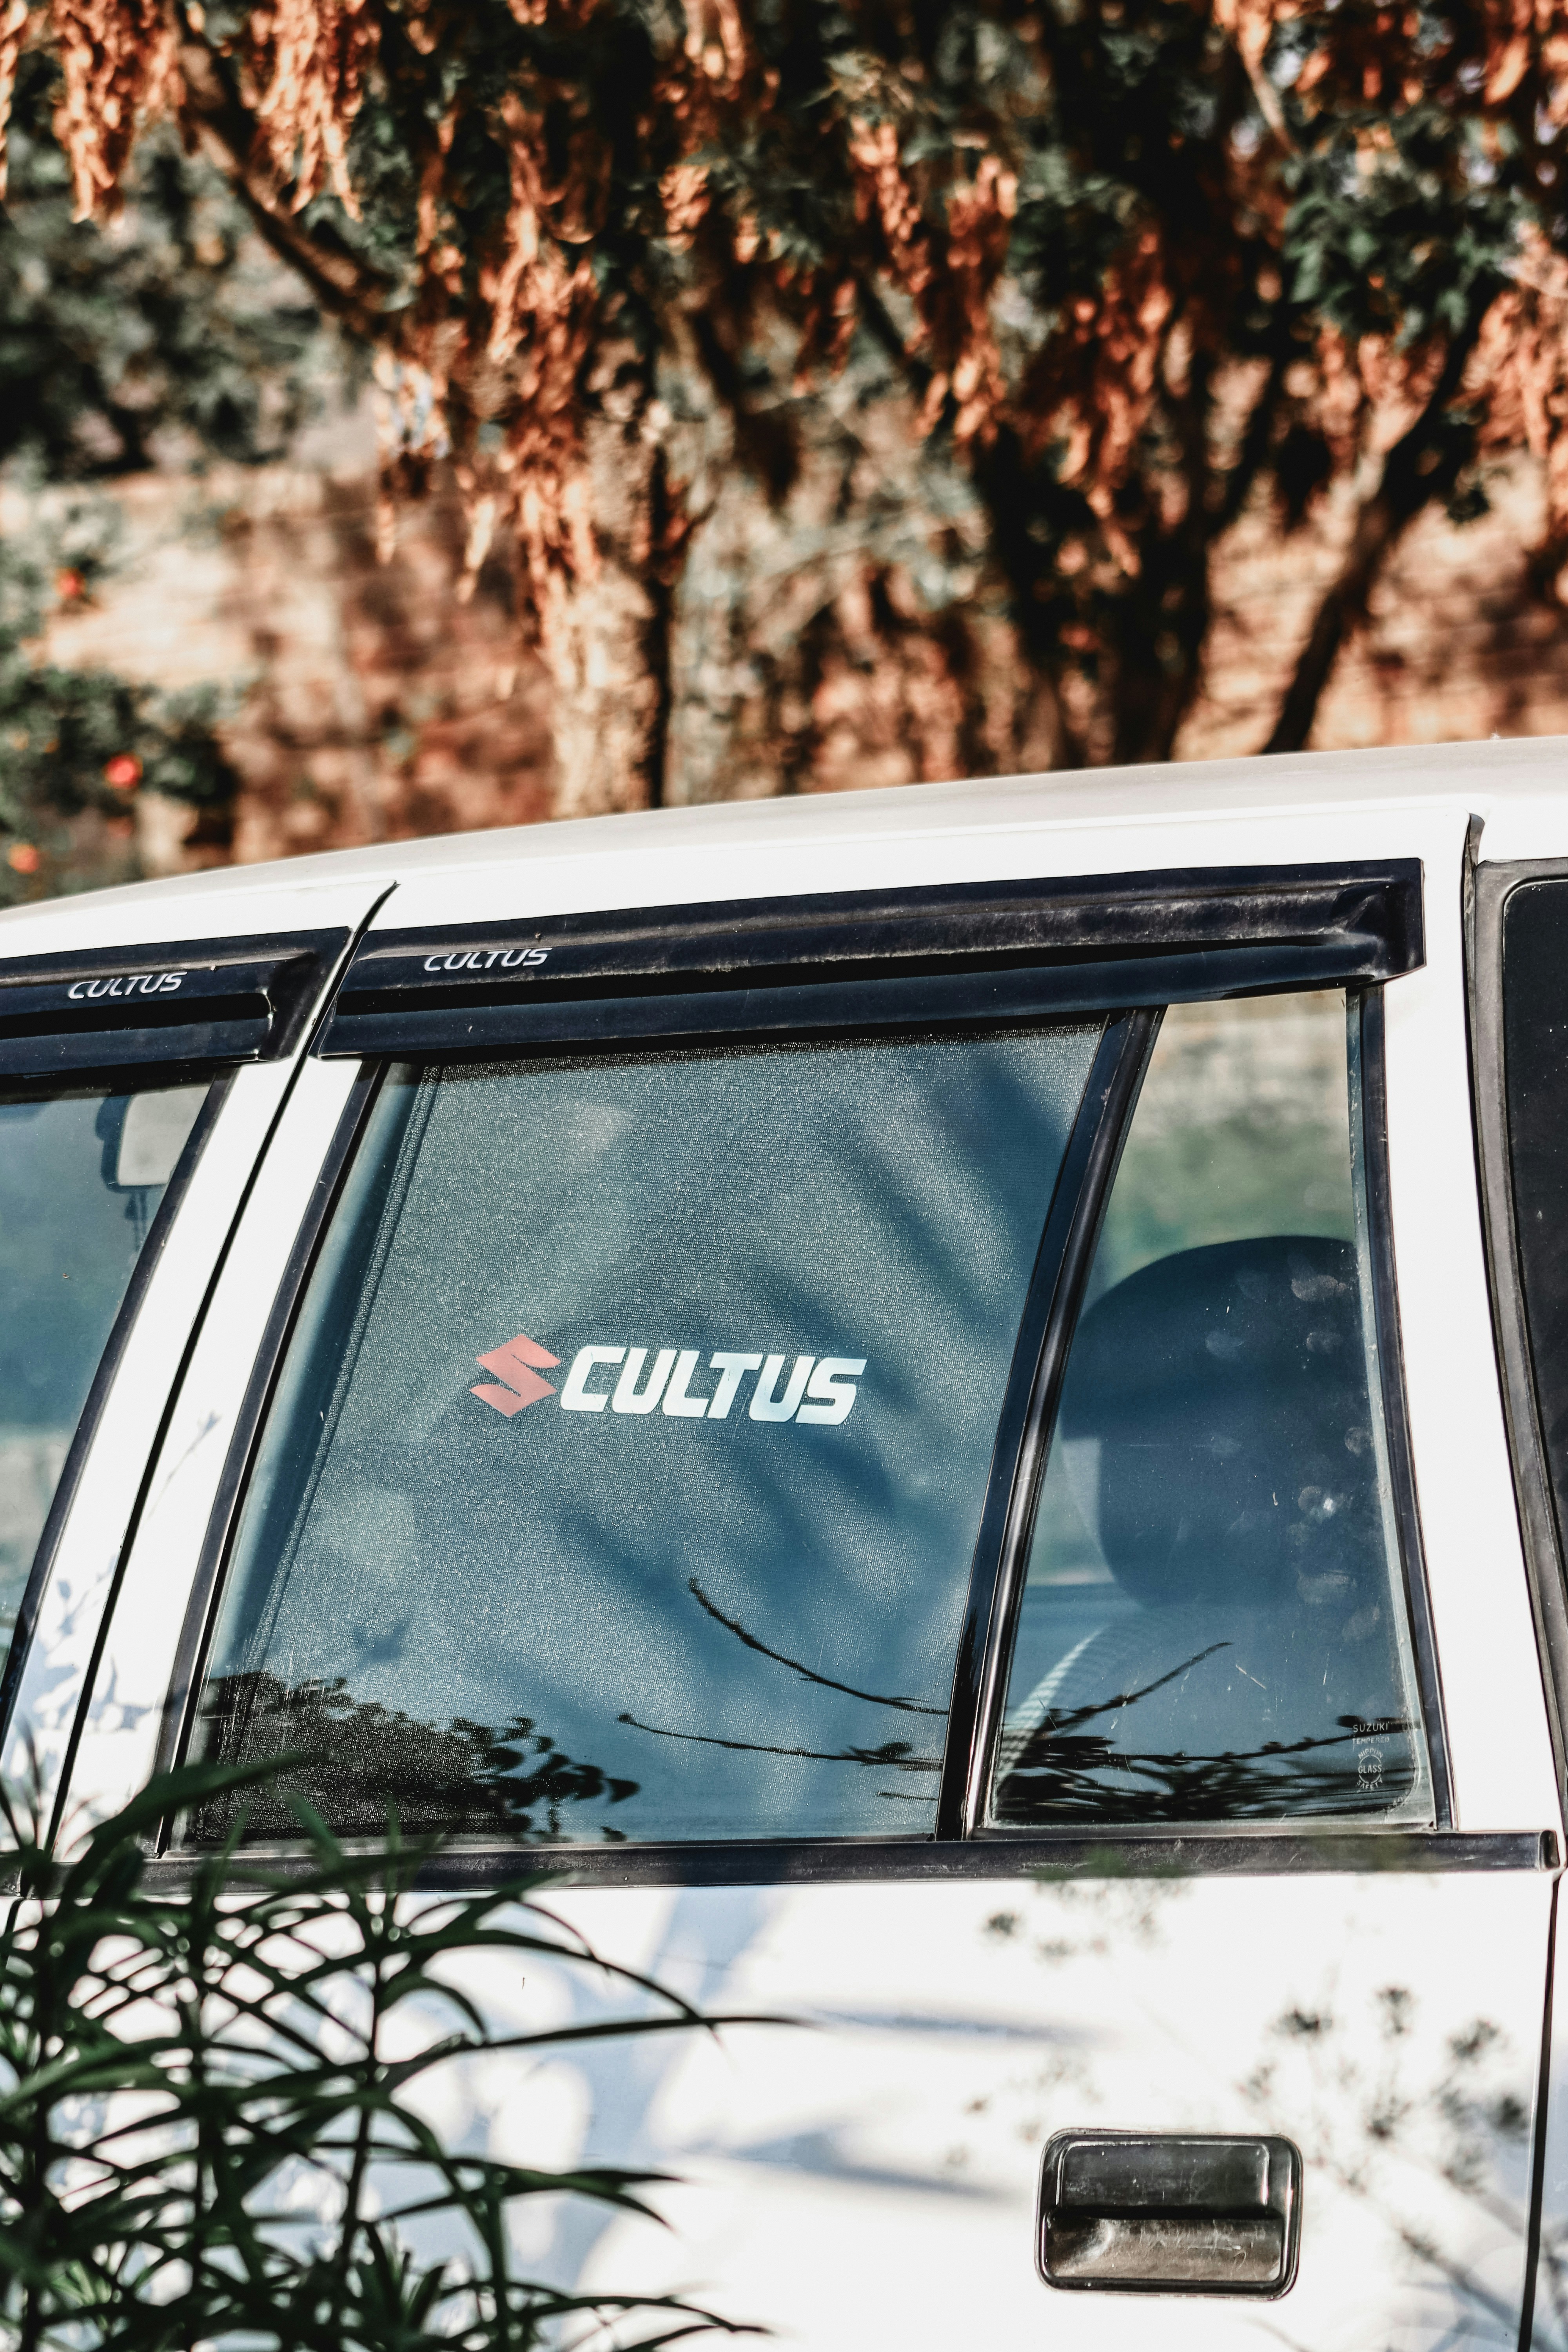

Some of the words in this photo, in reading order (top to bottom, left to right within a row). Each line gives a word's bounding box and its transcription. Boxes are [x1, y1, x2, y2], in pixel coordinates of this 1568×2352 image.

[424, 947, 553, 971] CULTUS
[68, 971, 188, 999] CULTUS
[560, 1346, 867, 1425] CULTUS
[1353, 1723, 1388, 1733] SUZUKI
[1358, 1748, 1383, 1759] NIPPON
[1358, 1764, 1382, 1774] GLASS
[1357, 1777, 1383, 1791] SAFETY
